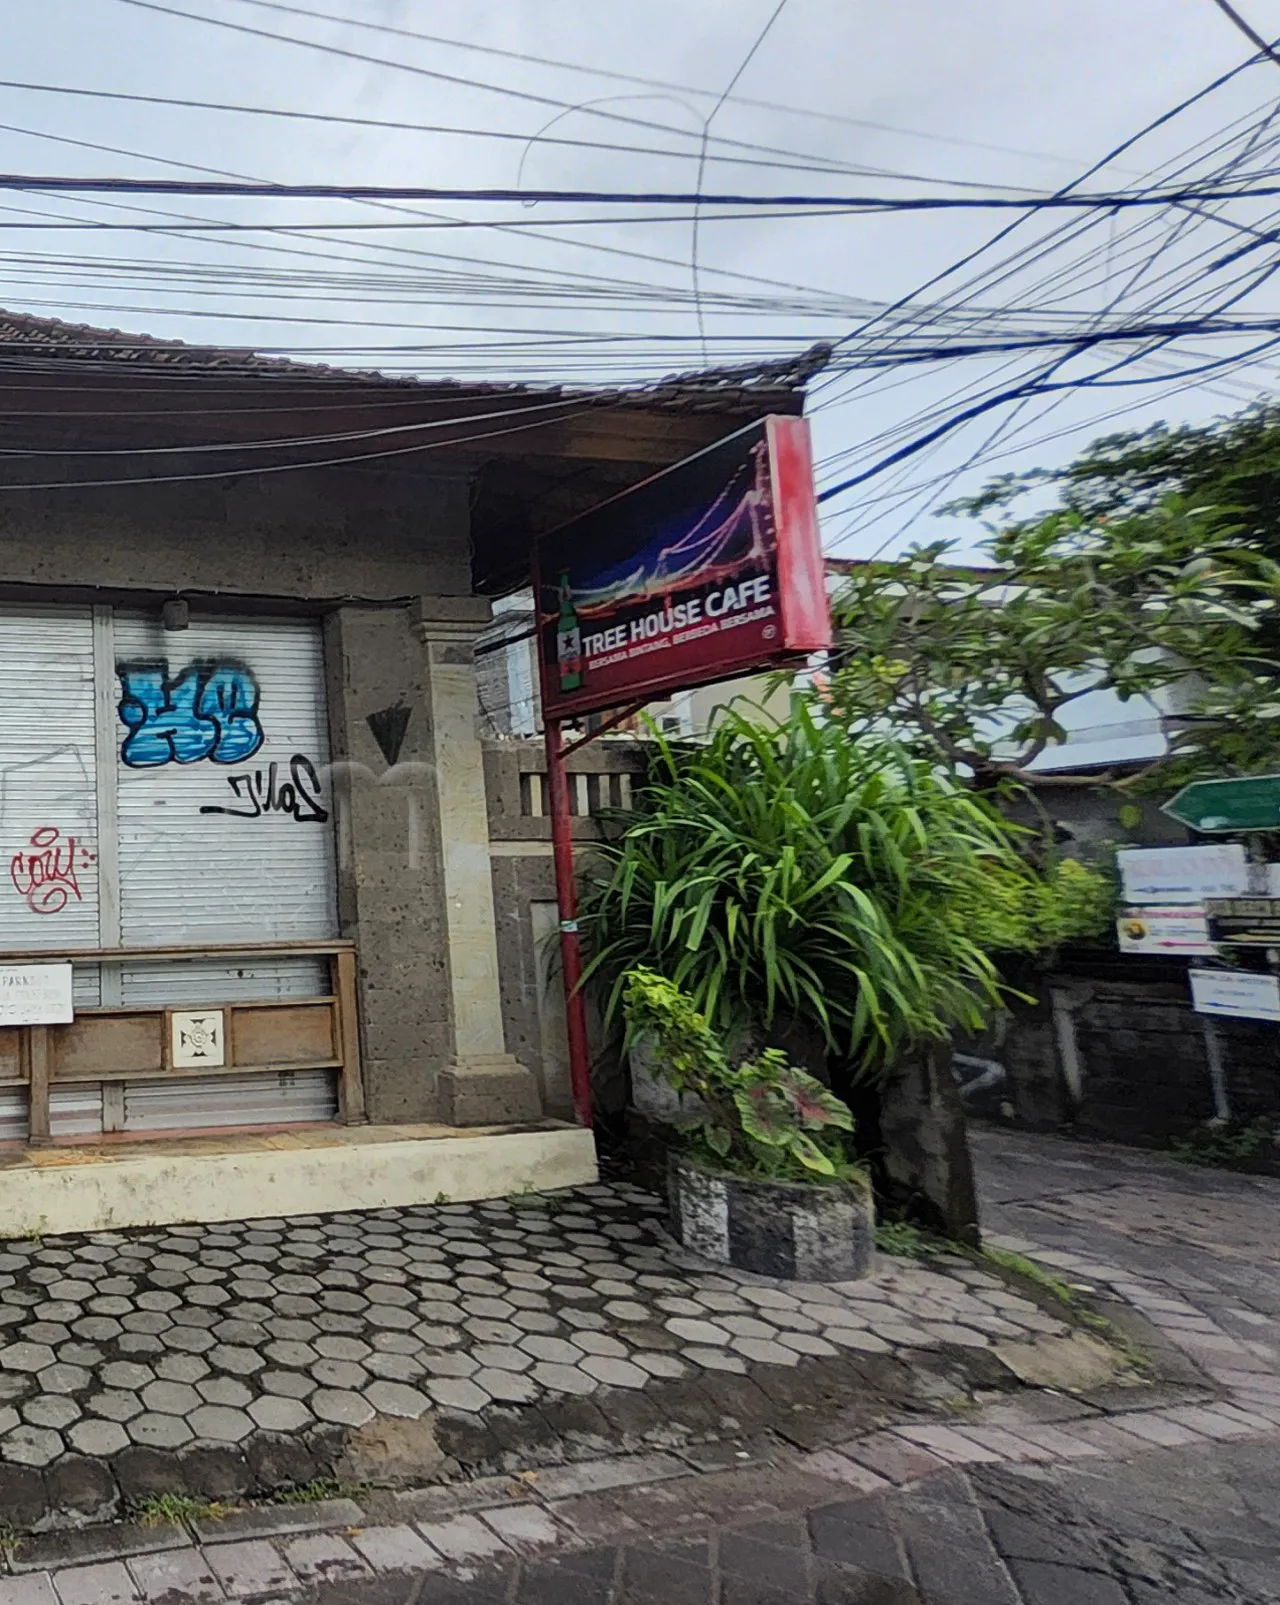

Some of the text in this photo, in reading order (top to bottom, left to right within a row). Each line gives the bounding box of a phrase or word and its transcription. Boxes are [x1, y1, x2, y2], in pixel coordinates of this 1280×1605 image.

[582, 575, 772, 658] TREE HOUSE CAFE
[720, 605, 776, 631] BERSAMA
